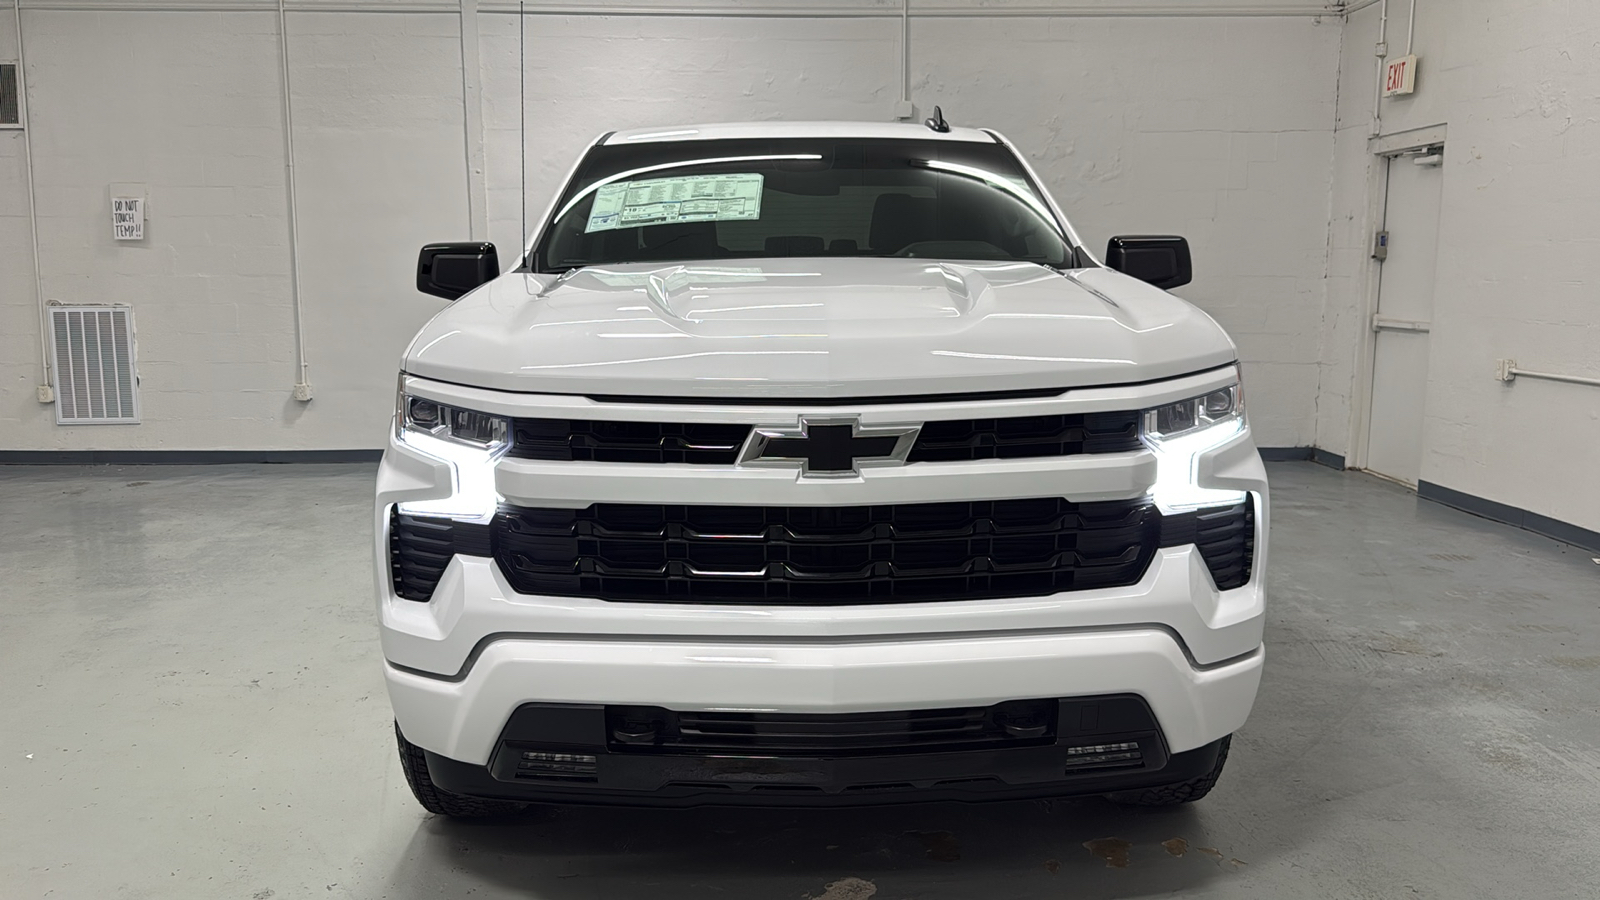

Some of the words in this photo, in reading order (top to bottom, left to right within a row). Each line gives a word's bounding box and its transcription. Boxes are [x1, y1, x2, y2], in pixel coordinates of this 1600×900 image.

[1387, 62, 1406, 91] EXIT
[115, 200, 122, 212] DO
[125, 200, 139, 212] NOT
[114, 213, 134, 224] TOUCH
[115, 224, 141, 237] TEMP!!
